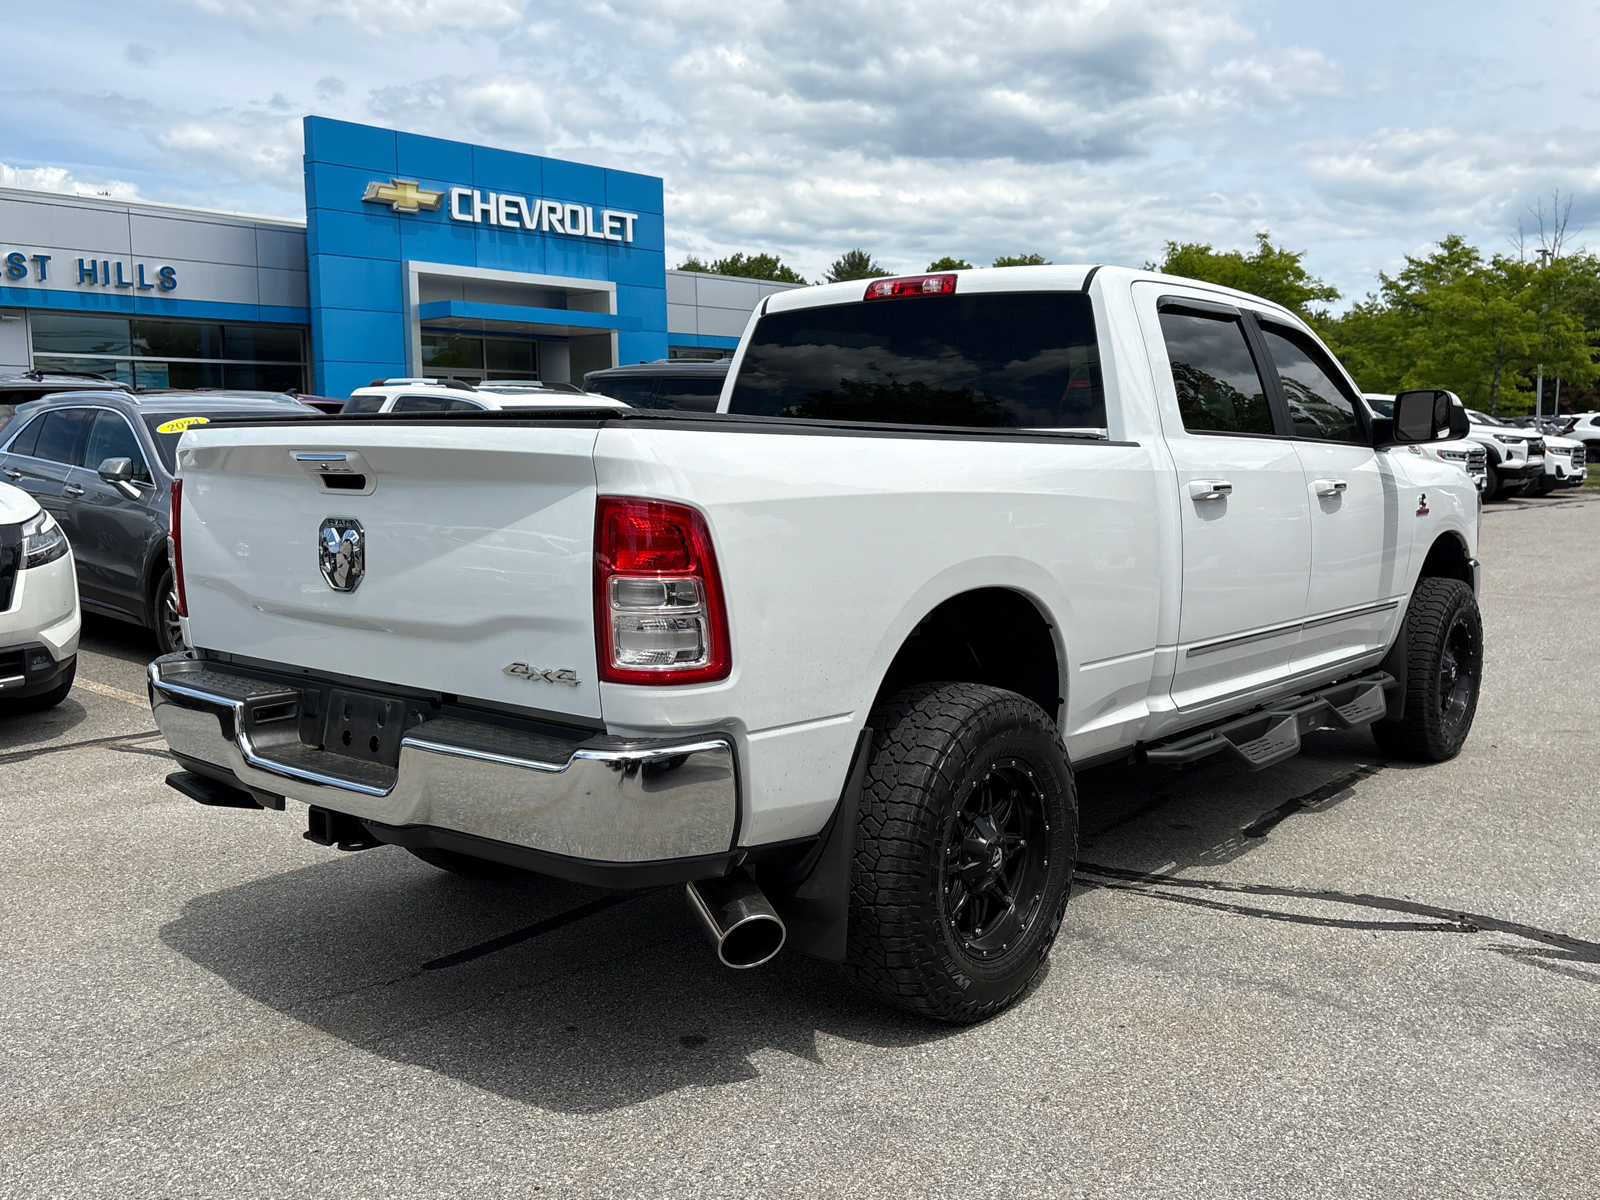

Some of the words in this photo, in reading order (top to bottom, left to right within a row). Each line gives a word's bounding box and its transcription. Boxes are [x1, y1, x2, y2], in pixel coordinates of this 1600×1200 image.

[450, 187, 638, 242] CHEVROLET
[0, 252, 52, 282] ST
[76, 257, 178, 291] HILLS
[327, 518, 354, 526] RAM
